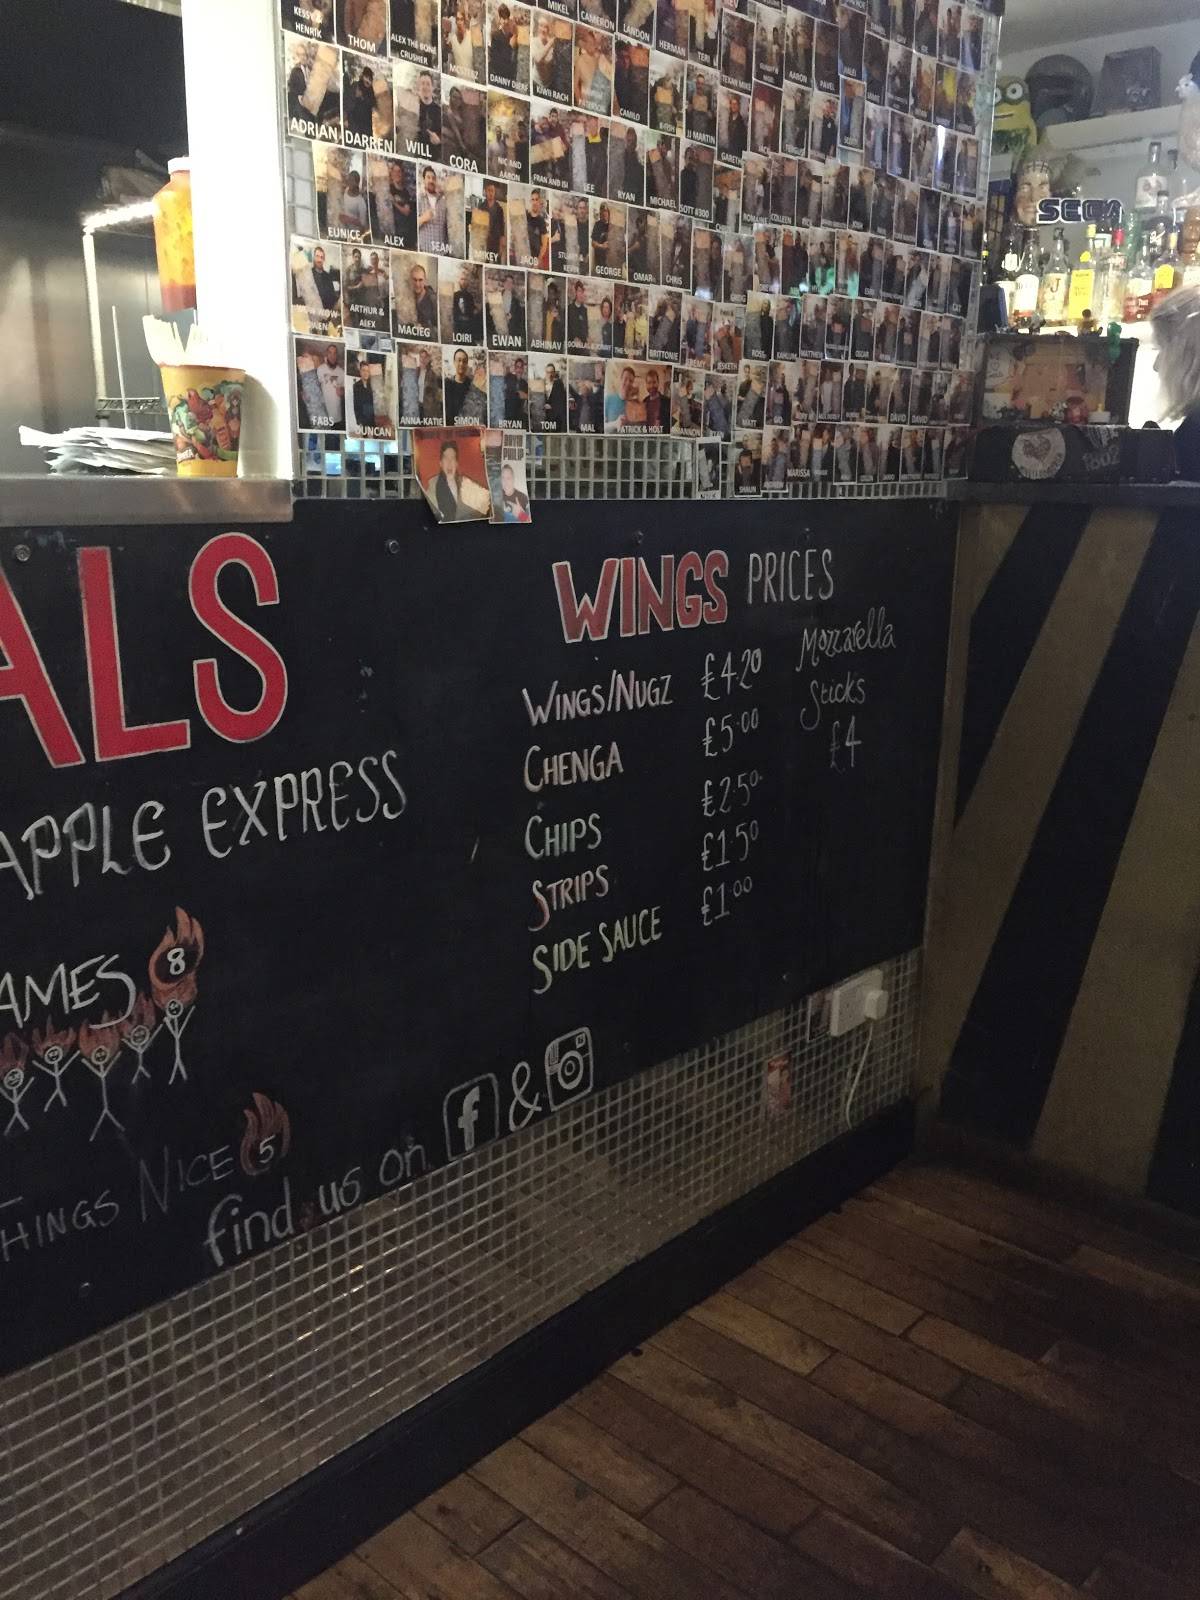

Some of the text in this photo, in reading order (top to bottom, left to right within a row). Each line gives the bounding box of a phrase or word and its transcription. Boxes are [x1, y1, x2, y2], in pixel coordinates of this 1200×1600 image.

[580, 10, 614, 32] CAMERON
[296, 21, 322, 39] HENRIK
[348, 34, 376, 53] THOM
[391, 33, 406, 45] ALEX
[400, 50, 428, 65] CRUSHER
[490, 73, 510, 87] DANNY
[291, 116, 337, 141] ADRIAN
[345, 130, 393, 154] DARREN
[406, 138, 432, 158] WILL
[449, 154, 478, 174] CORA
[617, 190, 636, 202] RYAN
[650, 196, 676, 210] MICHAEL
[1036, 197, 1123, 224] SEGA
[328, 226, 361, 241] EUNICE
[384, 234, 404, 248] ALEX
[431, 241, 452, 254] SEAN
[596, 265, 622, 278] GEORGE
[633, 272, 653, 283] OMAR
[350, 304, 378, 315] ARTHUR
[360, 319, 376, 328] ALEX
[492, 334, 522, 348] EWAN
[312, 416, 334, 427] FABS
[400, 416, 444, 426] ANNA-KATIE
[454, 416, 480, 426] SIMON
[498, 420, 522, 429] BRYAN
[540, 421, 557, 430] TOM
[580, 423, 596, 433] MAL
[355, 426, 392, 438] DUNCAN
[551, 548, 834, 644] WINGS PRICES
[829, 715, 862, 774] £4
[200, 749, 408, 859] EXPRESS
[167, 947, 187, 977] 8
[318, 1166, 362, 1217] us
[380, 1144, 427, 1187] on
[508, 1061, 543, 1133] &
[257, 1134, 277, 1165] 5
